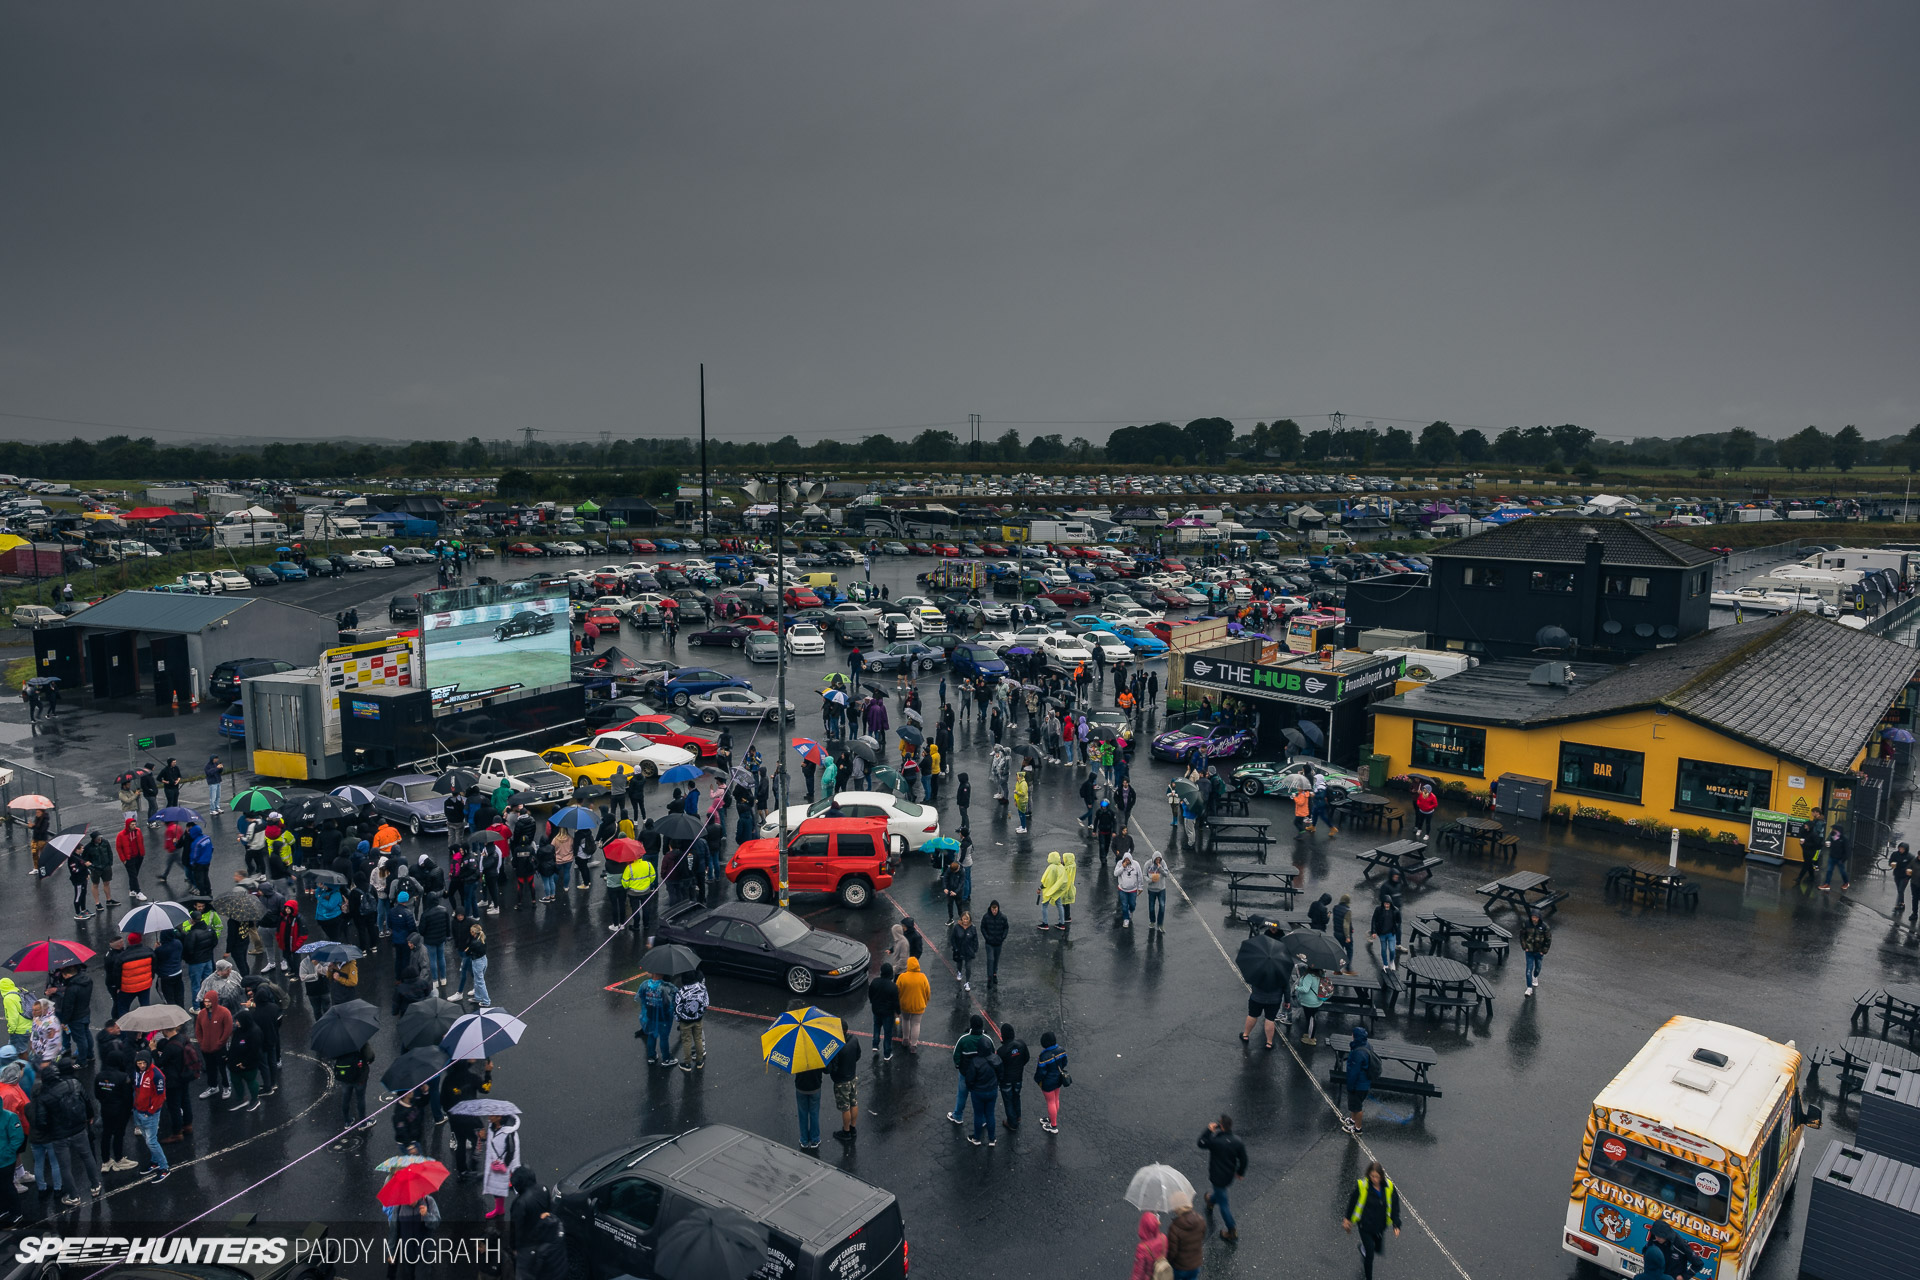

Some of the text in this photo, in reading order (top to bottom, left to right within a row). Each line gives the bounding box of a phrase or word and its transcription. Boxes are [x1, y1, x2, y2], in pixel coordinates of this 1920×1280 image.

[1216, 662, 1301, 691] THE HUB
[1430, 742, 1447, 750] MOTO
[1447, 745, 1464, 753] CAFE
[1593, 762, 1613, 777] BAR
[1706, 784, 1749, 797] MOTO CAFE
[1756, 826, 1782, 835] THRILLS
[1757, 820, 1782, 829] DRIVING
[1696, 1181, 1718, 1193] evian
[1581, 1177, 1731, 1243] CAUTION CHILDREN
[783, 1256, 796, 1271] LIFE
[828, 1254, 842, 1272] DRIFT
[841, 1244, 857, 1259] GAMES
[856, 1242, 867, 1251] LIFE
